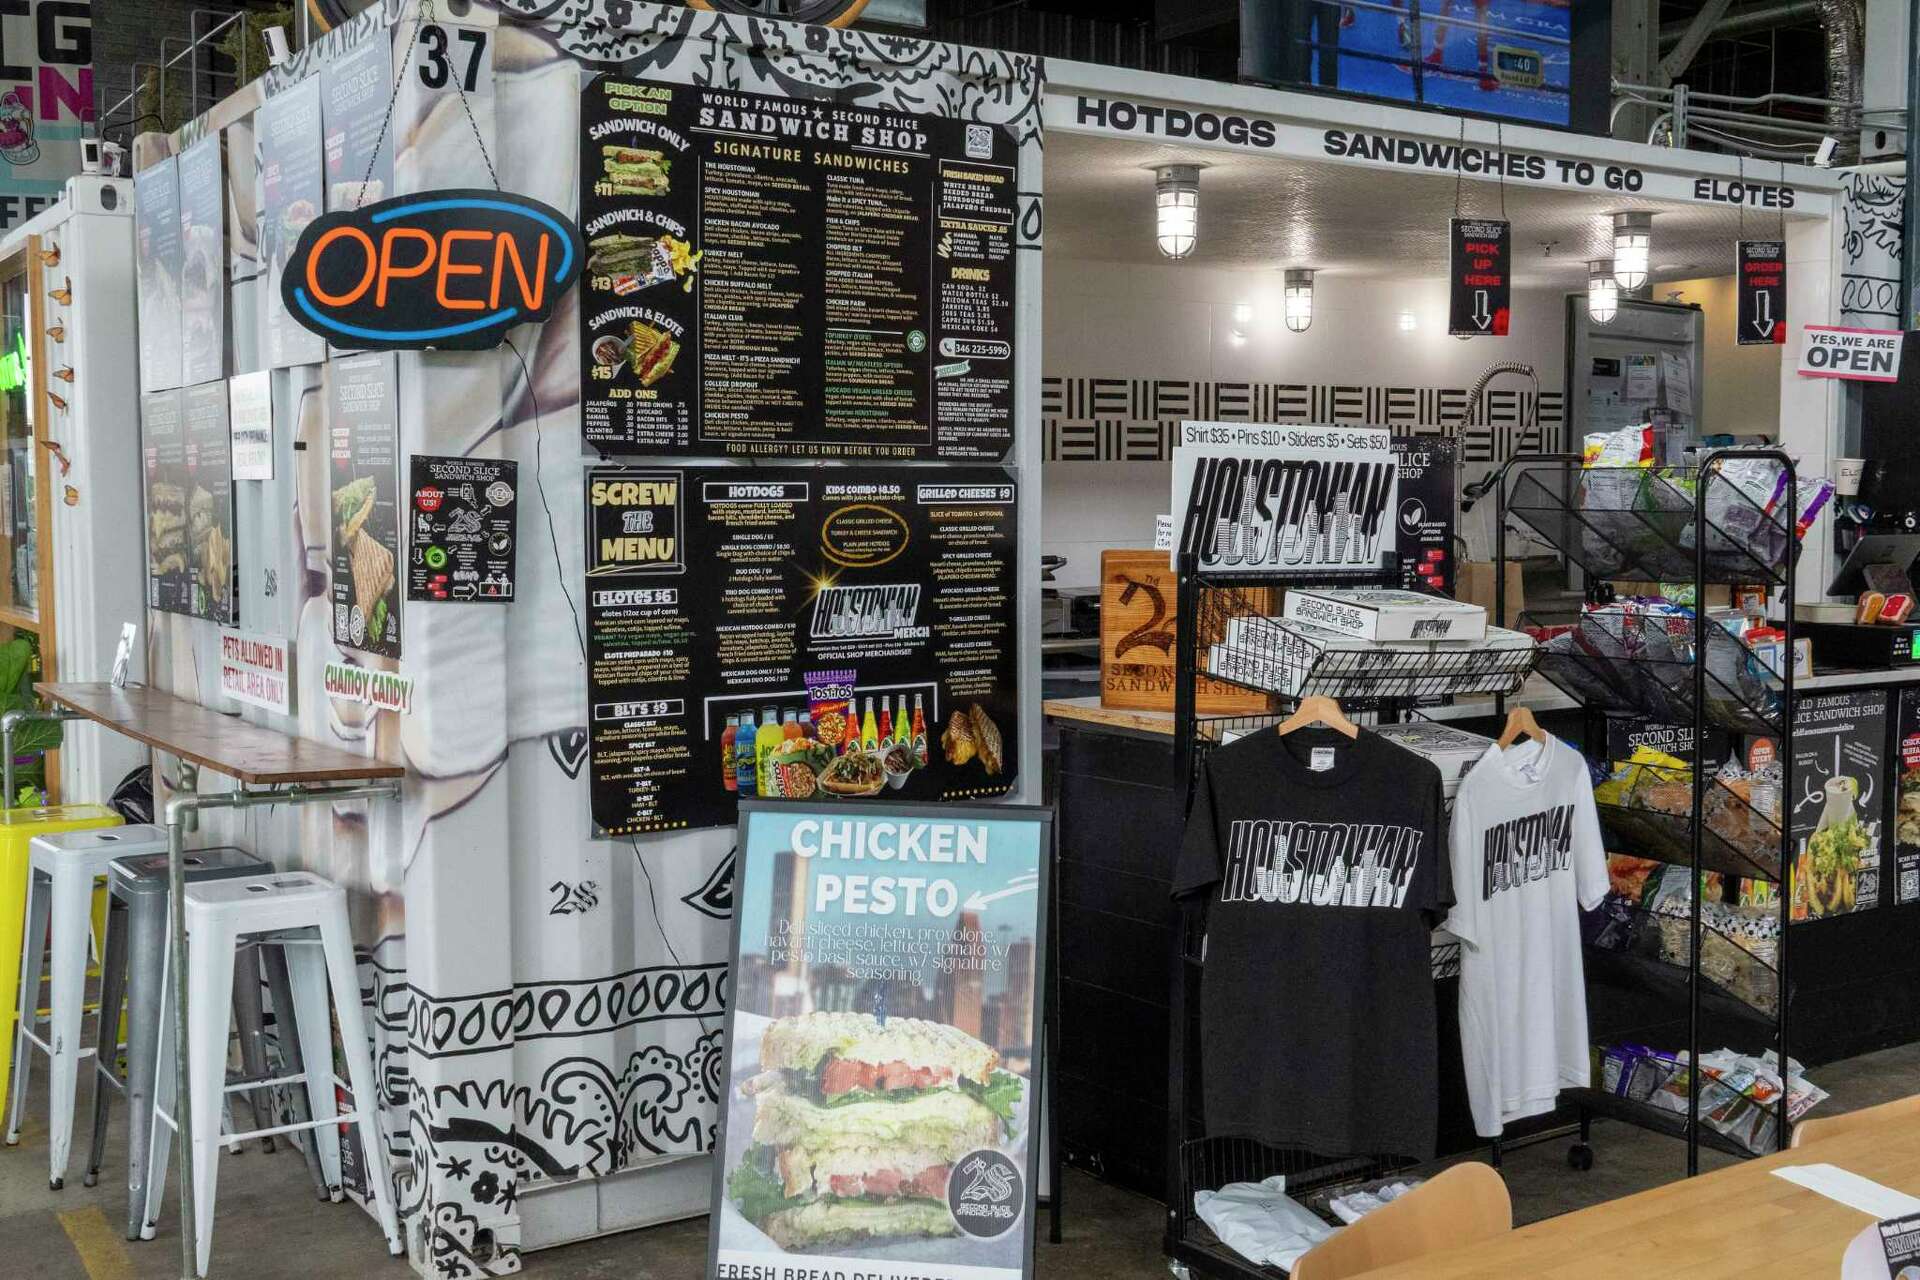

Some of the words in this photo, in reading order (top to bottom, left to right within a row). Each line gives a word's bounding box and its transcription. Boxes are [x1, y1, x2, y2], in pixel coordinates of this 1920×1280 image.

[418, 24, 487, 92] 37
[605, 82, 644, 96] PICK
[647, 88, 672, 101] AN
[609, 100, 667, 116] OPTION
[703, 93, 748, 108] WORLD
[755, 100, 808, 116] FAMOUS
[832, 110, 880, 125] SECOND
[886, 116, 918, 130] SLICE
[700, 107, 849, 142] SANDWICH
[861, 127, 928, 151] SHOP
[1077, 96, 1276, 148] HOTDOGS
[589, 118, 656, 141] SANDWICH
[656, 126, 691, 153] ONLY
[714, 140, 801, 163] SIGNATURE
[814, 152, 910, 174] SANDWICHES
[1324, 130, 1545, 180] SANDWICHES
[1556, 160, 1595, 185] TO
[1603, 166, 1643, 193] GO
[826, 174, 848, 183] CLASSIC
[850, 176, 864, 184] TUNA
[594, 181, 613, 197] $11
[722, 188, 760, 198] HOUSTONIAN
[1694, 178, 1794, 209] ELOTES
[586, 209, 645, 236] SANDWICH
[645, 210, 655, 223] &
[655, 214, 686, 238] CHIPS
[705, 218, 730, 226] CHICKEN
[730, 220, 750, 228] BACON
[752, 222, 780, 231] AVOCADO
[705, 250, 726, 258] TURKEY
[1464, 243, 1500, 256] PICK
[306, 226, 549, 312] OPEN
[1472, 258, 1492, 270] UP
[1744, 262, 1783, 273] ORDER
[826, 270, 850, 278] CHOPPED
[952, 266, 990, 282] DRINKS
[1464, 274, 1501, 286] HERE
[1749, 276, 1780, 287] HERE
[592, 276, 612, 292] $13
[757, 282, 772, 290] MELT
[588, 306, 643, 332] SANDWICH
[644, 306, 653, 319] &
[653, 308, 685, 338] ELOTE
[956, 343, 970, 354] 346
[972, 344, 1008, 356] 225-5996
[1866, 338, 1895, 349] ARE
[1807, 346, 1894, 373] OPEN
[592, 365, 613, 381] $15
[705, 380, 730, 388] COLLEGE
[608, 388, 632, 399] ADD
[634, 389, 658, 400] ONS
[1186, 427, 1209, 444] Shirt
[1210, 428, 1230, 445] $35
[1237, 430, 1260, 446] Pins
[1260, 430, 1280, 446] $10
[1287, 431, 1326, 448] Stickers
[1326, 432, 1340, 448] $5
[1346, 433, 1368, 450] Sets
[1368, 434, 1388, 451] $50
[726, 443, 747, 454] FOOD
[750, 444, 789, 454] ALLERGY?
[792, 445, 806, 454] LET
[809, 445, 818, 455] US
[821, 446, 842, 456] KNOW
[844, 446, 873, 456] BEFORE
[876, 446, 890, 456] YOU
[893, 447, 916, 457] ORDER
[1399, 453, 1430, 467] LICE
[430, 464, 471, 475] SECOND
[474, 466, 501, 477] SLICE
[434, 474, 475, 482] SANDWICH
[415, 490, 445, 498] ABOUT
[592, 482, 678, 506] SCREW
[728, 485, 784, 498] HOTDOGS
[825, 485, 846, 495] KIDS
[878, 484, 901, 494] $8.50
[958, 488, 996, 499] CHEESES
[1000, 488, 1011, 500] $9
[622, 510, 654, 534] THE
[602, 537, 675, 561] MENU
[656, 590, 672, 604] $6
[640, 610, 652, 618] cup
[1301, 598, 1334, 614] SECOND
[1335, 606, 1361, 620] SLICE
[1296, 606, 1338, 625] SANDWICH
[1340, 618, 1364, 630] SHOP
[894, 626, 930, 639] MERCH
[223, 636, 240, 660] PETS
[241, 640, 273, 670] ALLOWED
[274, 648, 284, 672] IN
[1111, 663, 1176, 678] SECON
[223, 667, 246, 693] RETAIL
[325, 664, 370, 702] CHAMOY
[370, 674, 409, 710] CANDY
[614, 704, 649, 717] BLT'S
[653, 702, 669, 715] $9
[1817, 696, 1850, 708] FAMOUS
[1813, 706, 1861, 722] SANDWICH
[1862, 704, 1886, 716] SHOP
[1628, 730, 1675, 748] SECOND
[791, 820, 988, 864] CHICKEN
[816, 874, 958, 918] PESTO
[808, 922, 851, 942] sliced
[937, 940, 988, 958] tomato
[818, 951, 852, 969] basil
[932, 955, 1001, 977] signature
[718, 1264, 777, 1278] FRESH
[784, 1268, 846, 1280] BREAD
